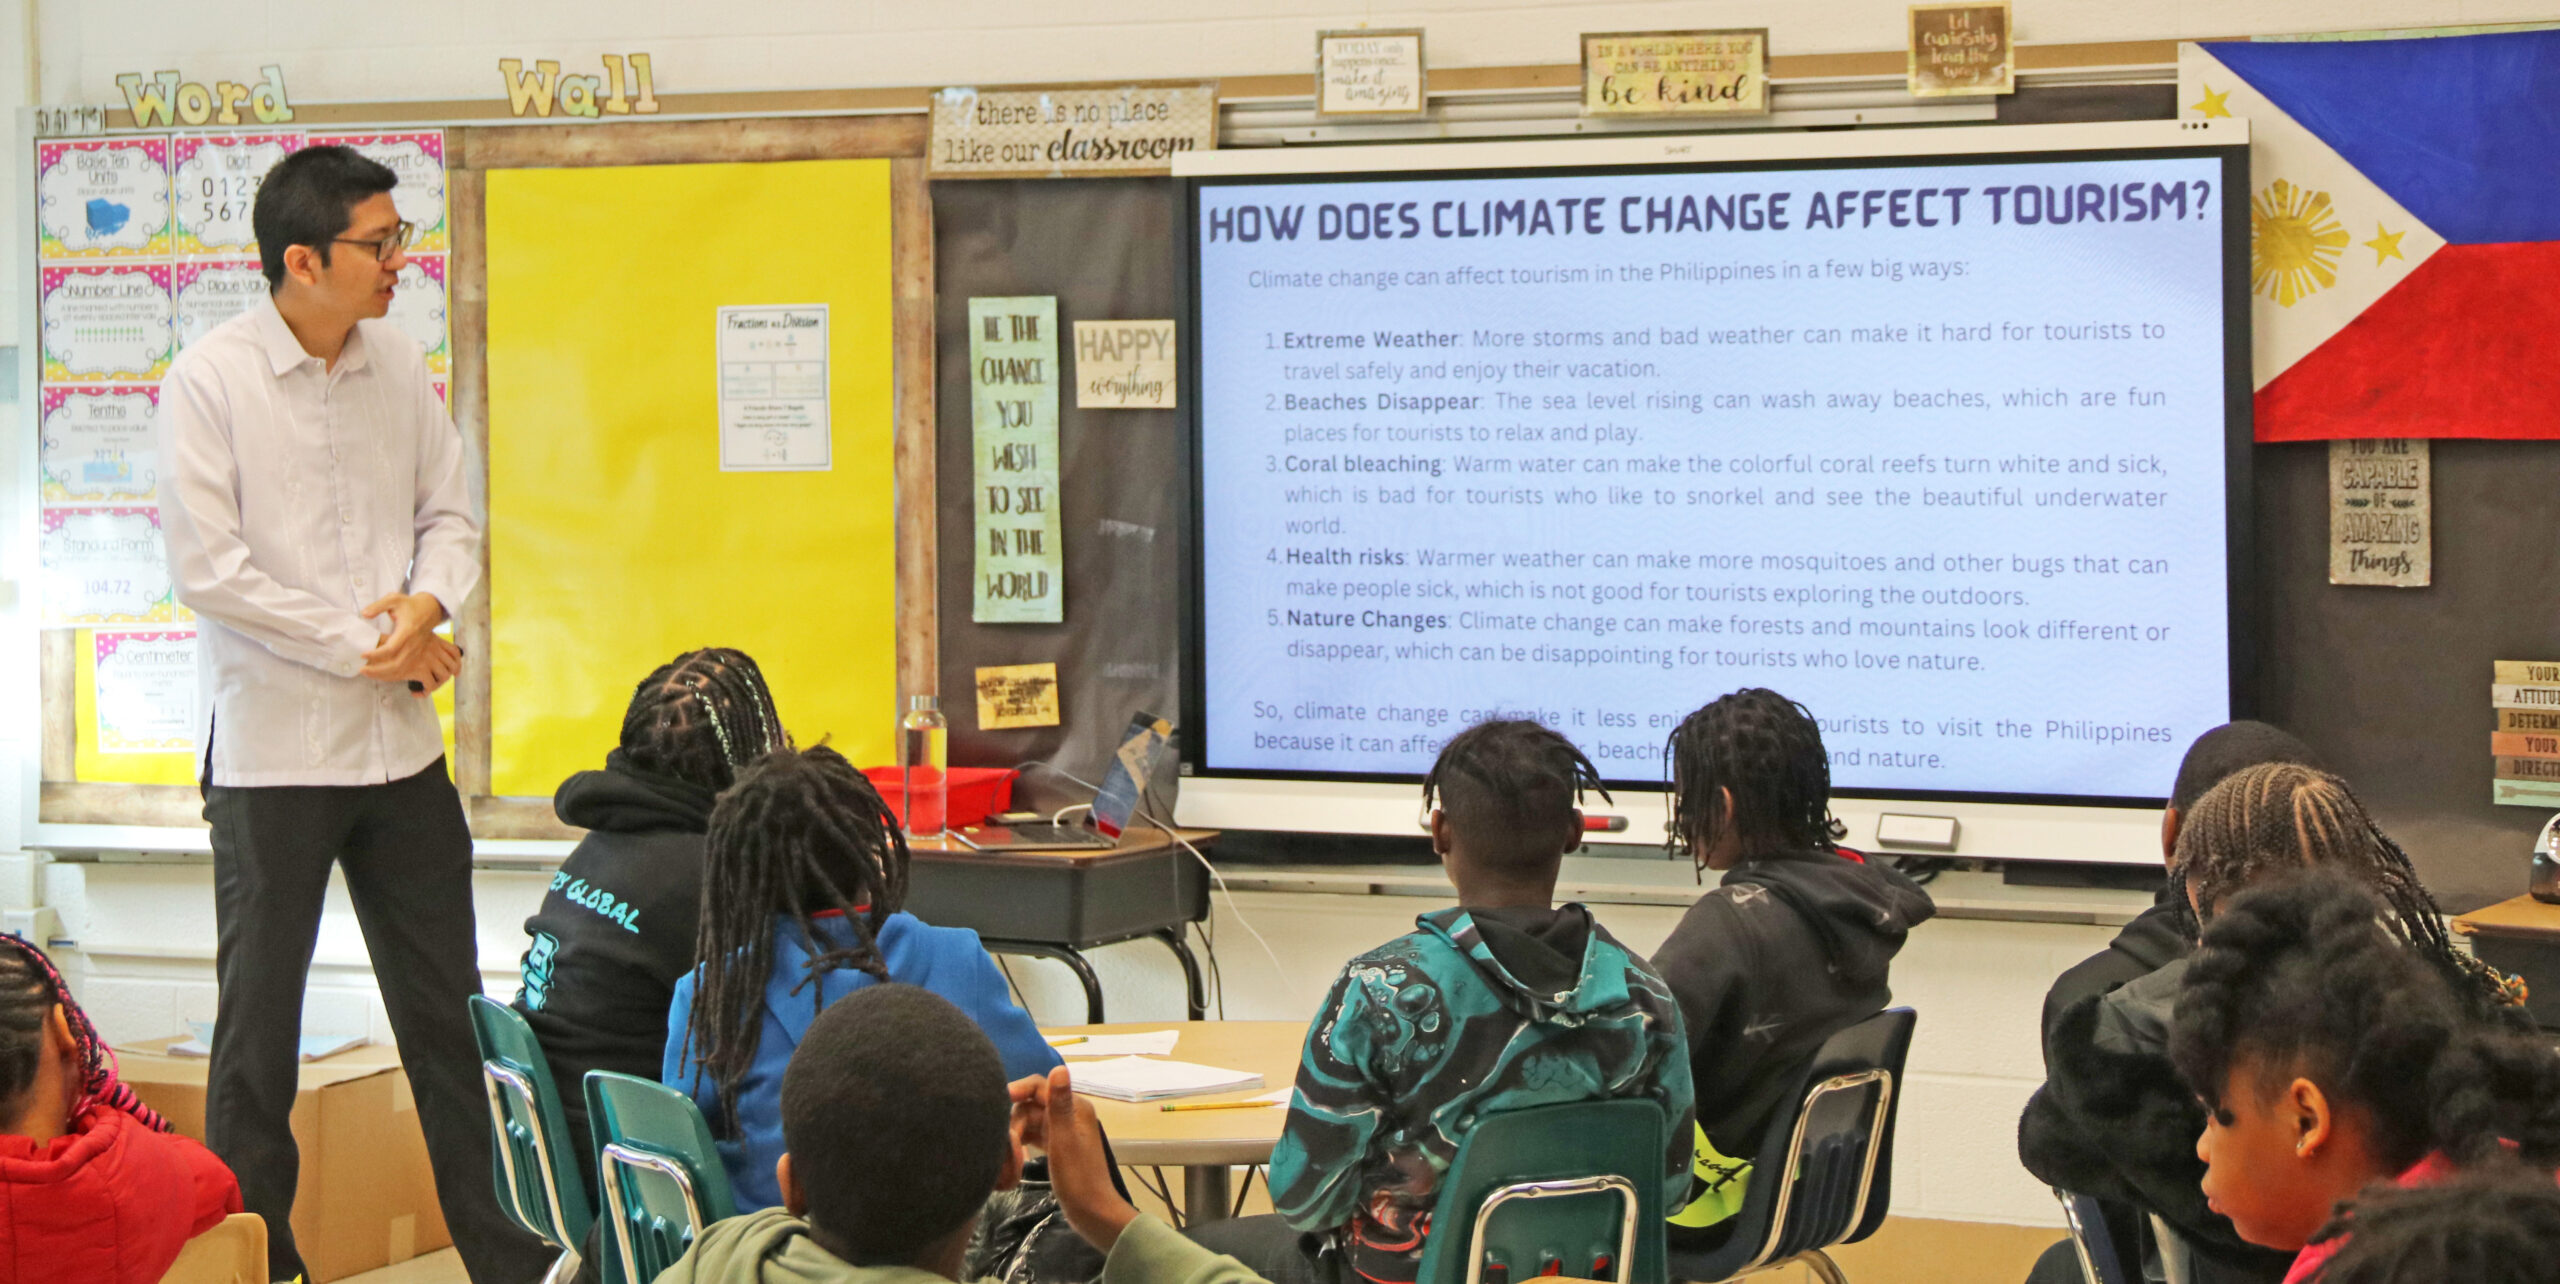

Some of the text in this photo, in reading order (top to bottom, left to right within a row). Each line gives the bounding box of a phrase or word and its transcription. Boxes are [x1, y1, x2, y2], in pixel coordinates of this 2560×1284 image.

[1629, 43, 1674, 57] WORLD
[1676, 42, 1723, 56] WHERE
[1614, 59, 1736, 74] CAN BE ANYTHING
[115, 64, 295, 129] Word
[498, 52, 661, 119] Wall
[1601, 73, 1750, 106] be kind
[977, 100, 1038, 125] there
[1074, 105, 1101, 124] no
[1107, 97, 1170, 129] place
[944, 128, 1195, 164] like our classroom
[1209, 179, 2212, 244] HOW DOES CLIMATE CHANGE AFFECT TOURISM?
[68, 283, 144, 297] Number Line
[208, 279, 240, 293] Place
[1248, 257, 1970, 292] Climate change can affect tourism in the Philippines in a few big ways:
[727, 314, 769, 330] Fractions
[782, 312, 820, 329] Division
[1008, 313, 1043, 344] THE
[1283, 331, 1366, 350] Extreme
[1372, 328, 1464, 349] Weather:
[1472, 329, 1526, 348] More
[1532, 329, 1605, 348] storms
[1612, 327, 1651, 347] and
[1659, 325, 1699, 346] bad
[1707, 325, 1795, 345] weather
[1803, 328, 1842, 344] can
[1851, 323, 1909, 343] make
[1917, 322, 1933, 343] it
[1941, 321, 1992, 342] hard
[2001, 320, 2035, 342] for
[2043, 320, 2133, 341] tourists
[2141, 321, 2166, 340] to
[1078, 327, 1171, 363] HAPPY
[980, 356, 1047, 387] CHANGE
[1088, 363, 1165, 404] everything
[1283, 358, 1661, 385] travel safely and enjoy their vacation.
[995, 399, 1033, 430] YOU
[1284, 392, 1368, 412] Beaches
[1377, 391, 1485, 416] Disappear:
[1495, 391, 1533, 411] The
[1542, 394, 1577, 411] sea
[1586, 391, 1637, 410] level
[1646, 390, 1704, 415] rising
[1713, 393, 1751, 410] can
[1761, 389, 1816, 409] wash
[1826, 392, 1882, 414] away
[1893, 388, 1991, 411] beaches,
[2002, 387, 2069, 408] which
[2080, 391, 2117, 408] are
[2127, 385, 2166, 407] fun
[1284, 422, 1643, 447] places for tourists to relax and play.
[2350, 438, 2410, 455] YOU ARE
[991, 442, 1038, 473] WISH
[1284, 454, 1339, 473] Coral
[1343, 453, 1446, 479] bleaching:
[1453, 455, 1512, 473] Warm
[1518, 456, 1577, 473] water
[1582, 458, 1620, 474] can
[1626, 454, 1681, 474] make
[1687, 454, 1723, 474] the
[1729, 453, 1813, 474] colorful
[1819, 454, 1875, 474] coral
[1881, 453, 1937, 474] reefs
[1943, 456, 1991, 474] turn
[1998, 453, 2061, 474] white
[2067, 453, 2110, 474] and
[2117, 453, 2168, 478] sick,
[2342, 458, 2419, 490] CAPABLE
[985, 485, 1046, 516] TO SEE
[2372, 492, 2387, 509] OF
[988, 527, 1047, 557] IN THE
[2341, 512, 2421, 545] AMAZING
[84, 579, 132, 596] 104.72
[985, 571, 1049, 603] WORLD
[126, 649, 193, 663] Centimeter
[2526, 665, 2560, 682] YOUR
[2513, 688, 2560, 705] ATTITU
[2508, 712, 2560, 730] DETERM
[2525, 736, 2558, 754] YOUR
[565, 878, 641, 935] GLOBAL
